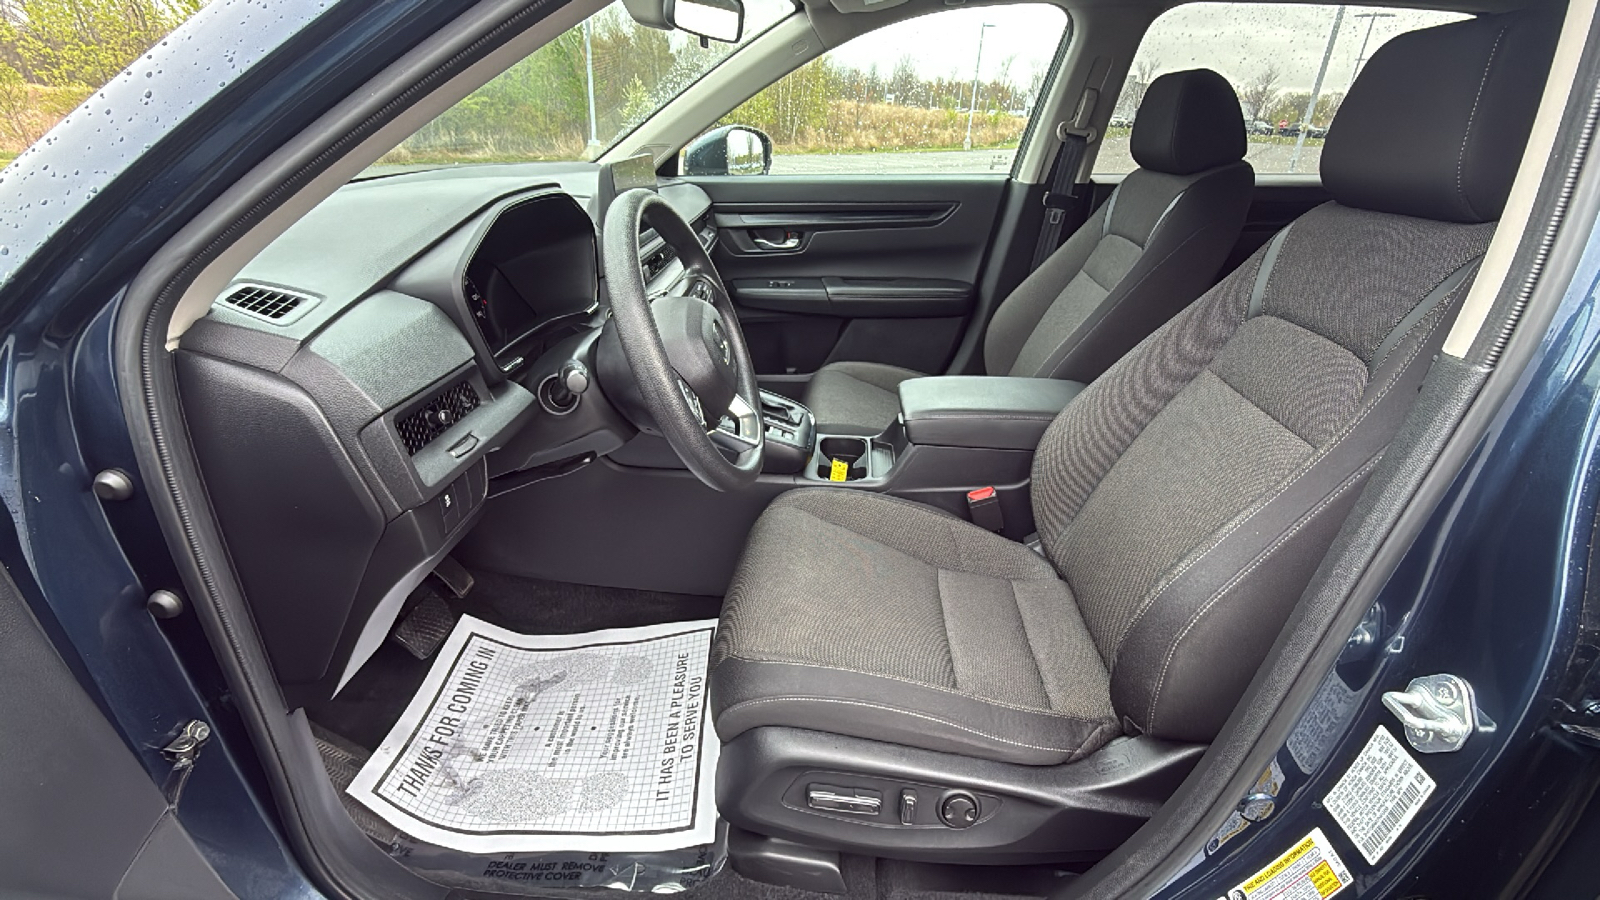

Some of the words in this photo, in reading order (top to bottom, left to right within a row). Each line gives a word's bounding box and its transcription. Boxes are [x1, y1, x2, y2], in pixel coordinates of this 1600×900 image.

[671, 652, 689, 708] PLEASURE
[689, 676, 702, 701] YOU
[397, 746, 443, 797] THANKS
[430, 716, 460, 746] FOR
[448, 660, 488, 714] COMING
[476, 646, 496, 660] IN
[482, 736, 496, 751] HAVE
[489, 719, 504, 735] TRIED
[502, 696, 513, 710] KEEP
[553, 741, 564, 756] most
[570, 694, 581, 712] person
[669, 710, 681, 718] A
[682, 701, 699, 742] SERVE
[548, 716, 562, 742] customer
[664, 722, 680, 754] BEEN
[486, 746, 501, 764] YOUR
[498, 744, 512, 760] WITH
[600, 744, 610, 759] Your
[680, 744, 694, 762] TO
[658, 757, 675, 786] HAS
[656, 790, 670, 802] IT
[483, 870, 544, 880] PROTECTIVE
[544, 872, 582, 880] COVER
[488, 861, 527, 871] DEALER
[530, 862, 558, 871] MUST
[562, 862, 606, 872] REMOVE
[1243, 881, 1255, 892] TIRE
[1253, 874, 1265, 885] AND
[1263, 860, 1285, 878] LOADING
[1281, 837, 1315, 865] INFORMATION
